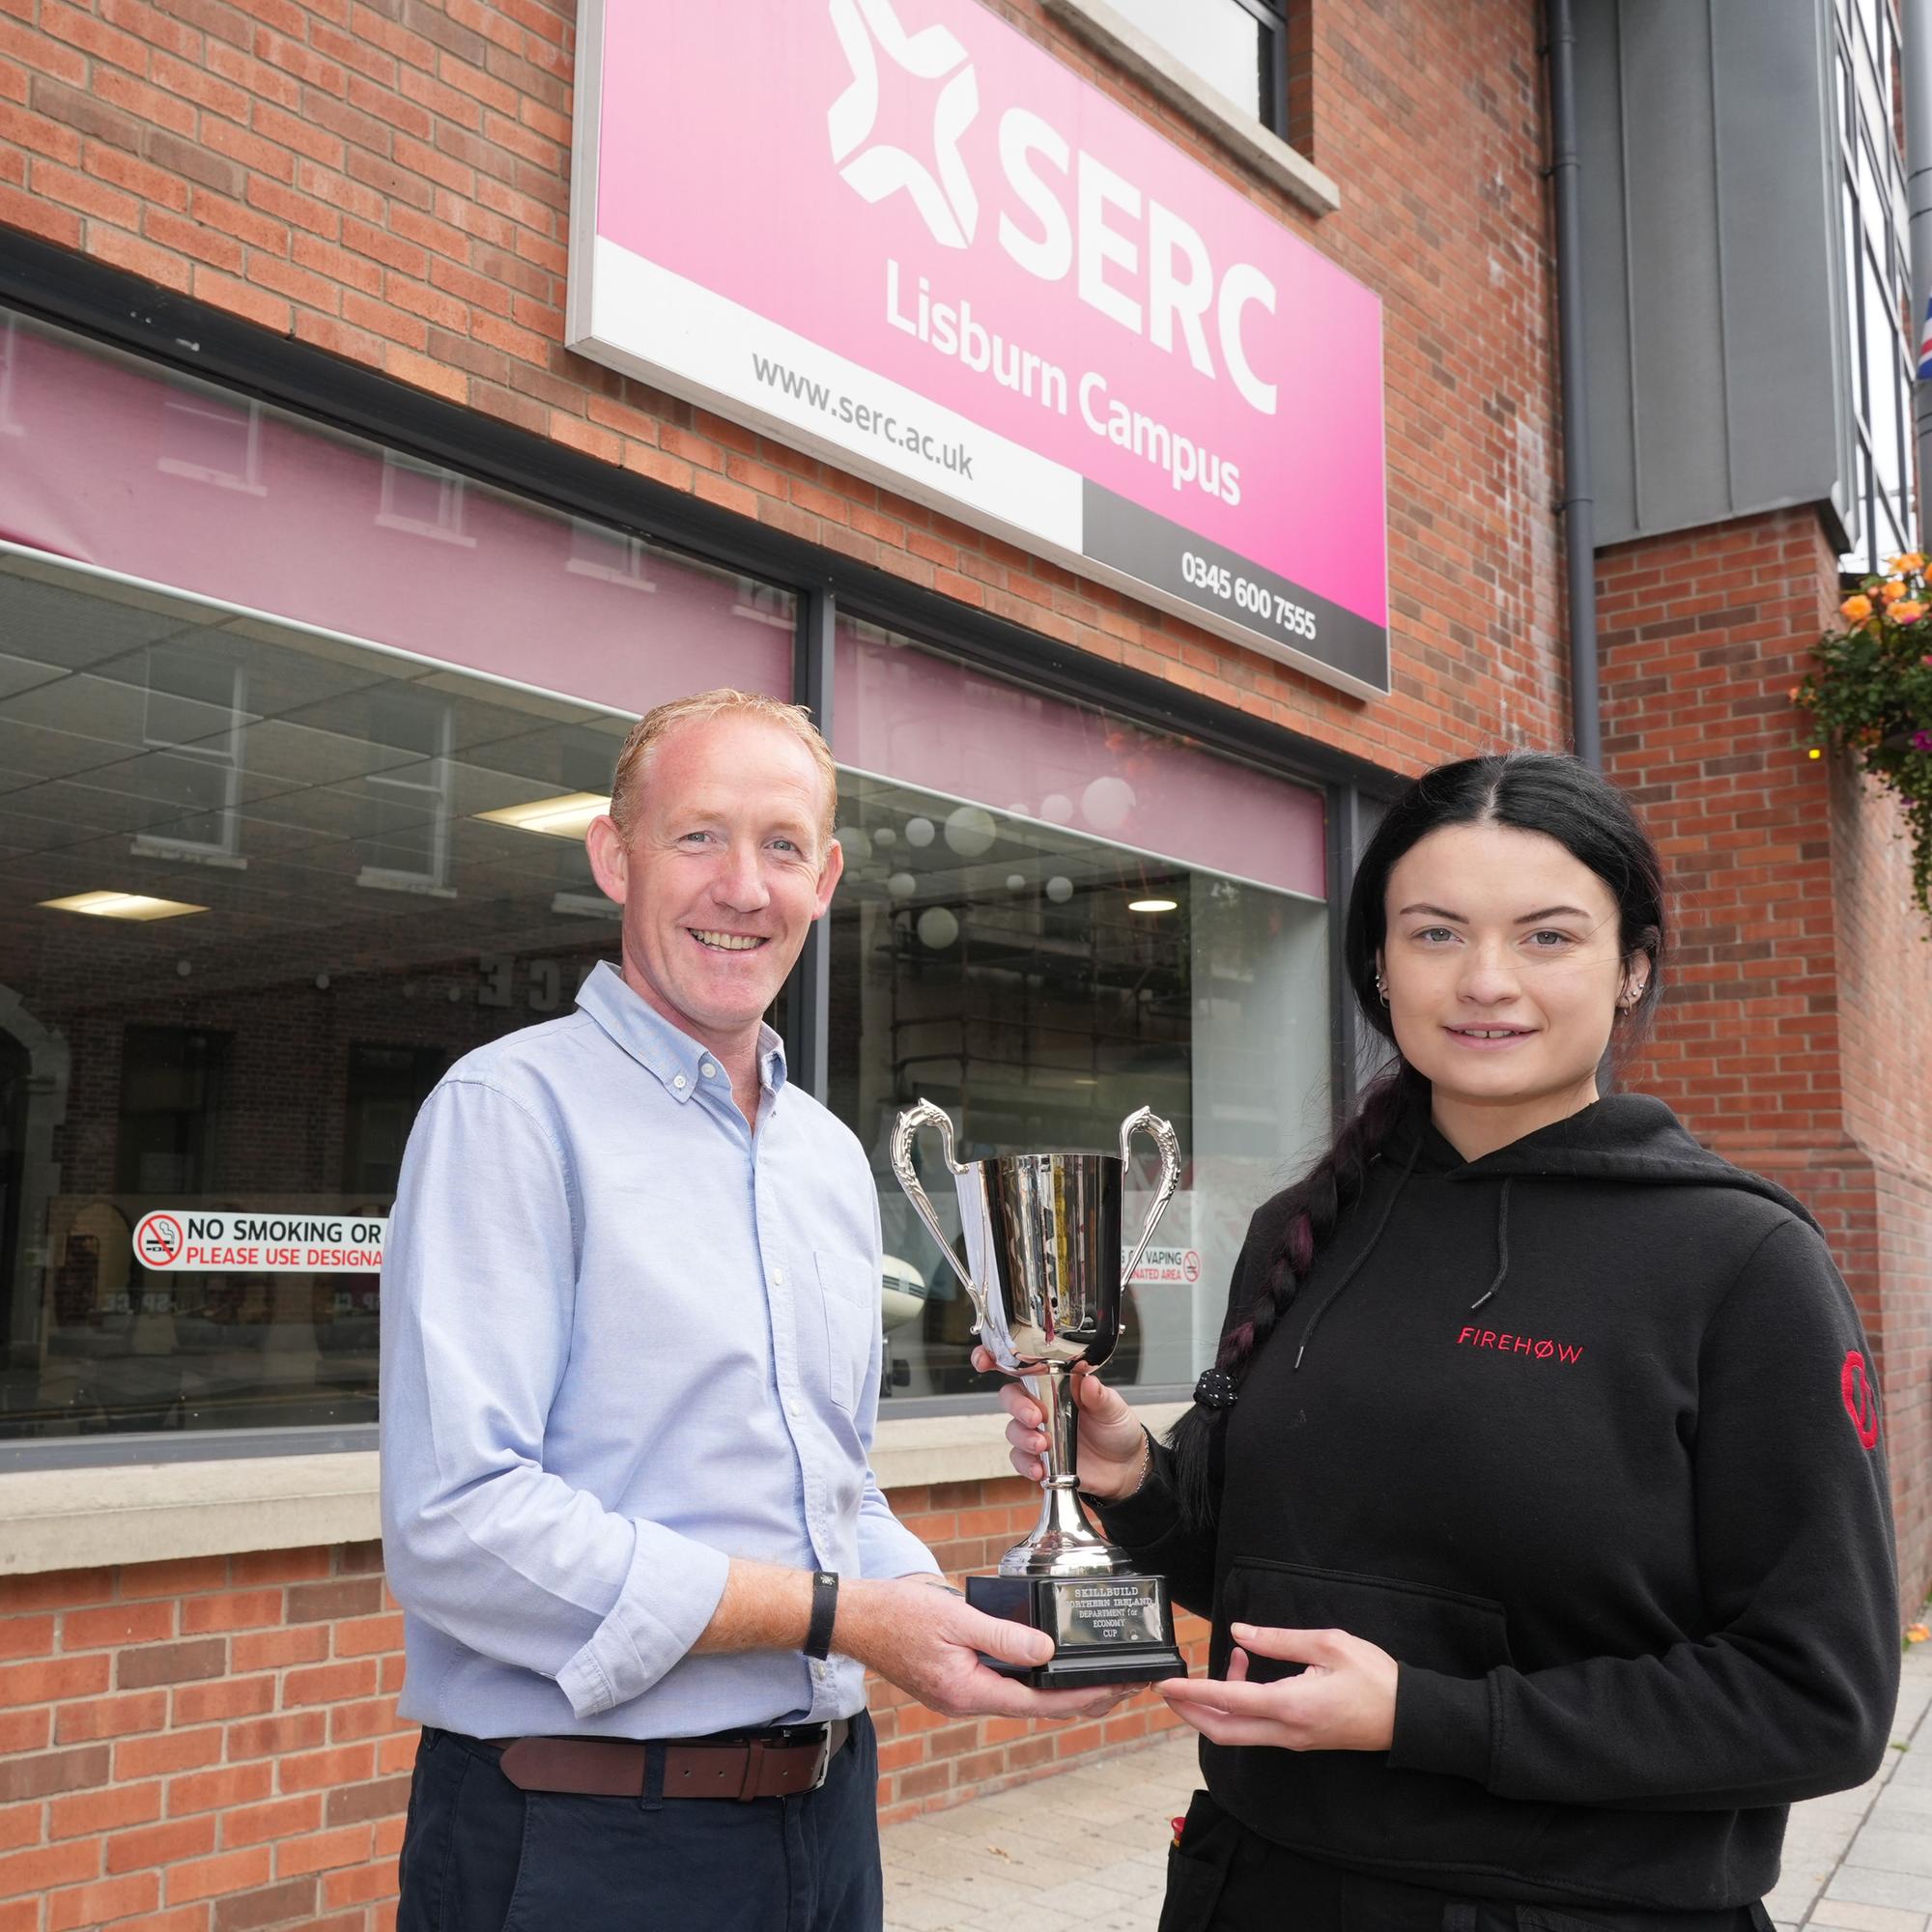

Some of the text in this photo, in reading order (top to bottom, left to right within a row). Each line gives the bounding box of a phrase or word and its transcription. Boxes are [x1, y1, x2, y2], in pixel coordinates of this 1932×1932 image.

[998, 107, 1277, 415] SERC
[886, 258, 1240, 506] Lisburn Campus
[753, 353, 973, 480] www.serc.ac.uk
[1181, 552, 1316, 640] 0345 600 7555
[187, 1218, 382, 1243] NO SMOKING OR
[186, 1246, 383, 1266] PLEASE USE DESIGNA
[1146, 1251, 1181, 1264] VAPING
[1161, 1269, 1181, 1280] AREA
[1074, 1587, 1139, 1598] SKILLBUILD
[1114, 1597, 1152, 1606] IRELAND
[1079, 1607, 1125, 1618] DEPARTMENT
[1093, 1619, 1126, 1628] ECONOMY
[1102, 1629, 1118, 1637] CUP
